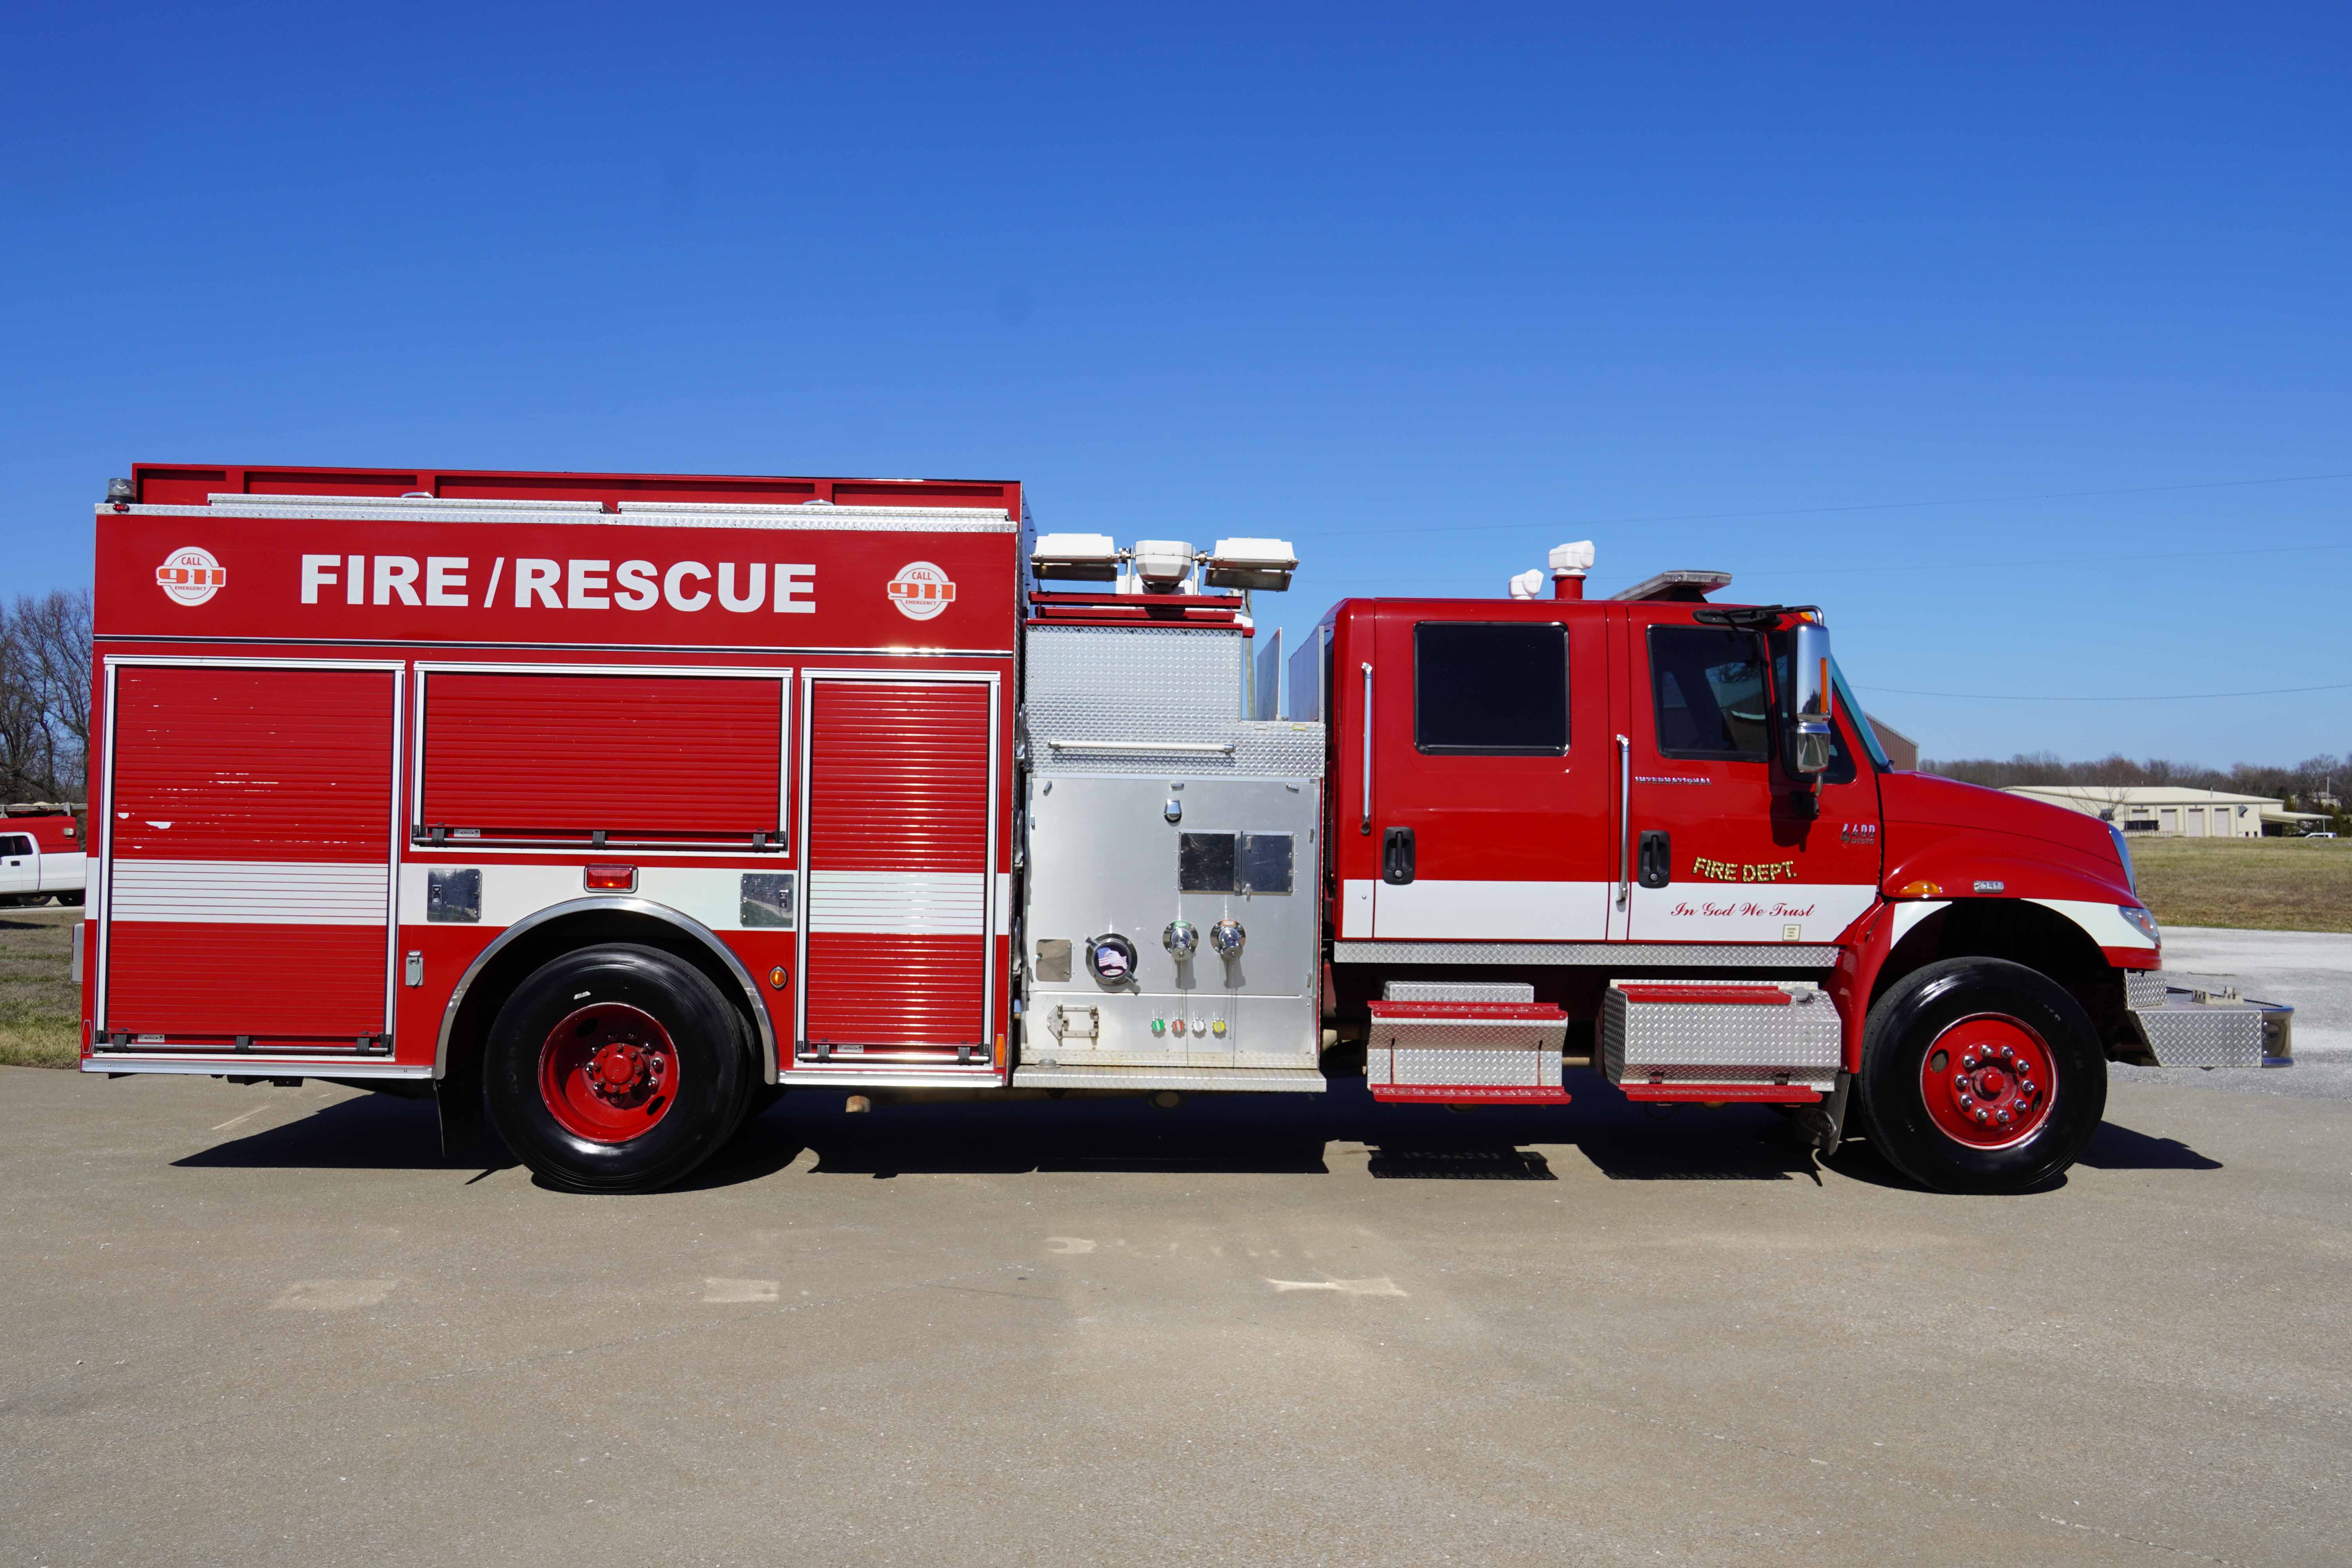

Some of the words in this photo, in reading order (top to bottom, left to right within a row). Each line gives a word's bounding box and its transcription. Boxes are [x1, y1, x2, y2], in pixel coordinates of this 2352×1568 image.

[181, 557, 202, 565] CALL
[1635, 776, 1712, 785] INTERNATIONAL
[1841, 823, 1875, 843] 4400
[1692, 856, 1738, 881] FIRE
[1742, 860, 1798, 882] DEPT.
[1671, 902, 1698, 916] In
[1702, 902, 1736, 916] God
[1739, 902, 1767, 916] We
[1769, 902, 1815, 916] Trust
